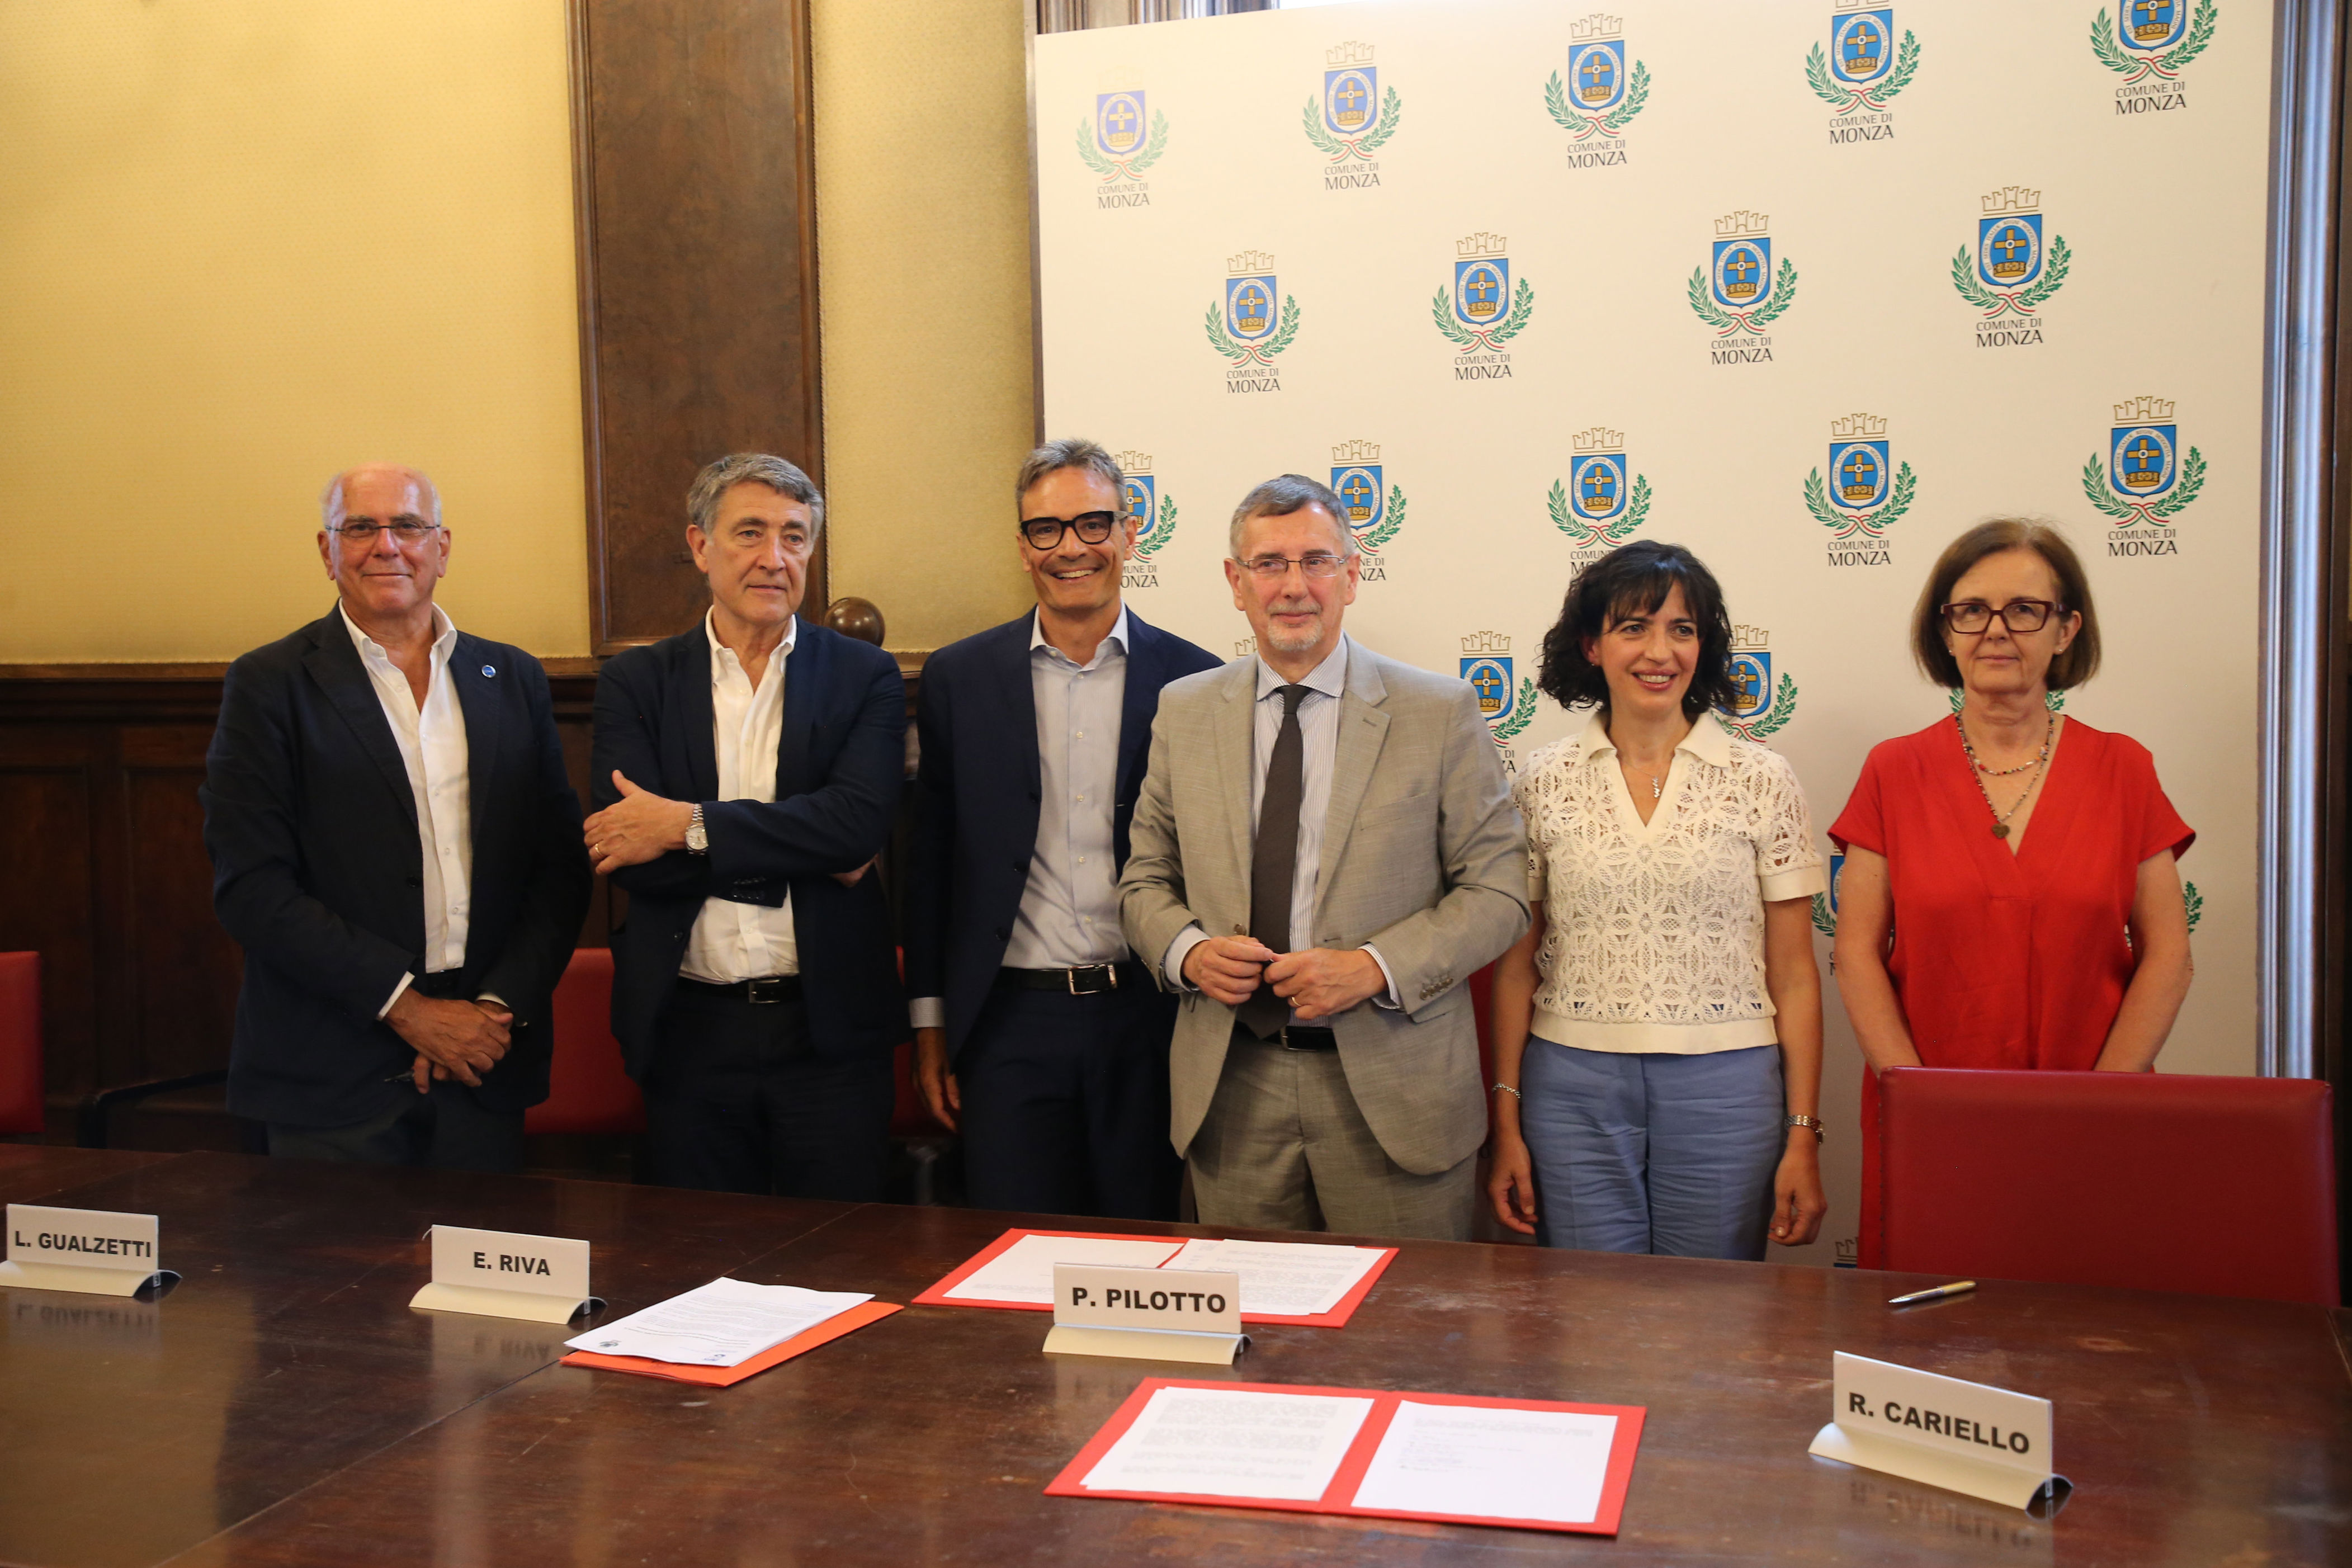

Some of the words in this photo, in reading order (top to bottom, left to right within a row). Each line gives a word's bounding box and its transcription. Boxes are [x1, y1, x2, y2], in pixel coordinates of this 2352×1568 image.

[2116, 84, 2167, 97] COMUNE
[2173, 82, 2184, 92] DI
[2115, 94, 2186, 115] MONZA
[1829, 115, 1877, 127] COMUNE
[1881, 114, 1892, 122] DI
[1829, 125, 1893, 144] MONZA
[1567, 141, 1610, 153] COMUNE
[1615, 140, 1625, 149] DI
[1567, 151, 1627, 169] MONZA
[1324, 164, 1365, 175] COMUNE
[1369, 163, 1378, 171] DI
[1098, 183, 1136, 194] COMUNE
[1139, 183, 1148, 191] DI
[1325, 173, 1380, 190] MONZA
[1098, 193, 1150, 209] MONZA
[1976, 319, 2025, 331] COMUNE
[2030, 318, 2041, 327] DI
[1711, 339, 1756, 349] COMUNE
[1761, 337, 1771, 346] DI
[1976, 330, 2043, 347] MONZA
[1454, 356, 1496, 365] COMUNE
[1711, 348, 1773, 365] MONZA
[1227, 369, 1265, 379] COMUNE
[1269, 369, 1278, 377] DI
[1455, 365, 1512, 380] MONZA
[1227, 379, 1281, 393] MONZA
[2108, 529, 2159, 540] COMUNE
[2164, 529, 2175, 537] DI
[1828, 540, 1874, 550] COMUNE
[1879, 540, 1889, 549] DI
[2108, 540, 2178, 556] MONZA
[1570, 550, 1617, 559] COMUN
[1827, 551, 1891, 566] MONZA
[1121, 575, 1159, 588] ONZA
[1359, 568, 1386, 580] NZA
[15, 1231, 31, 1247] L.
[39, 1233, 151, 1258] GUALZETTI
[474, 1251, 492, 1269] E.
[500, 1254, 551, 1276] RIVA
[1072, 1287, 1096, 1306] P.
[1107, 1288, 1226, 1314] PILOTTO
[1849, 1392, 1874, 1417] R.
[1884, 1402, 2029, 1454] CARIELLO
